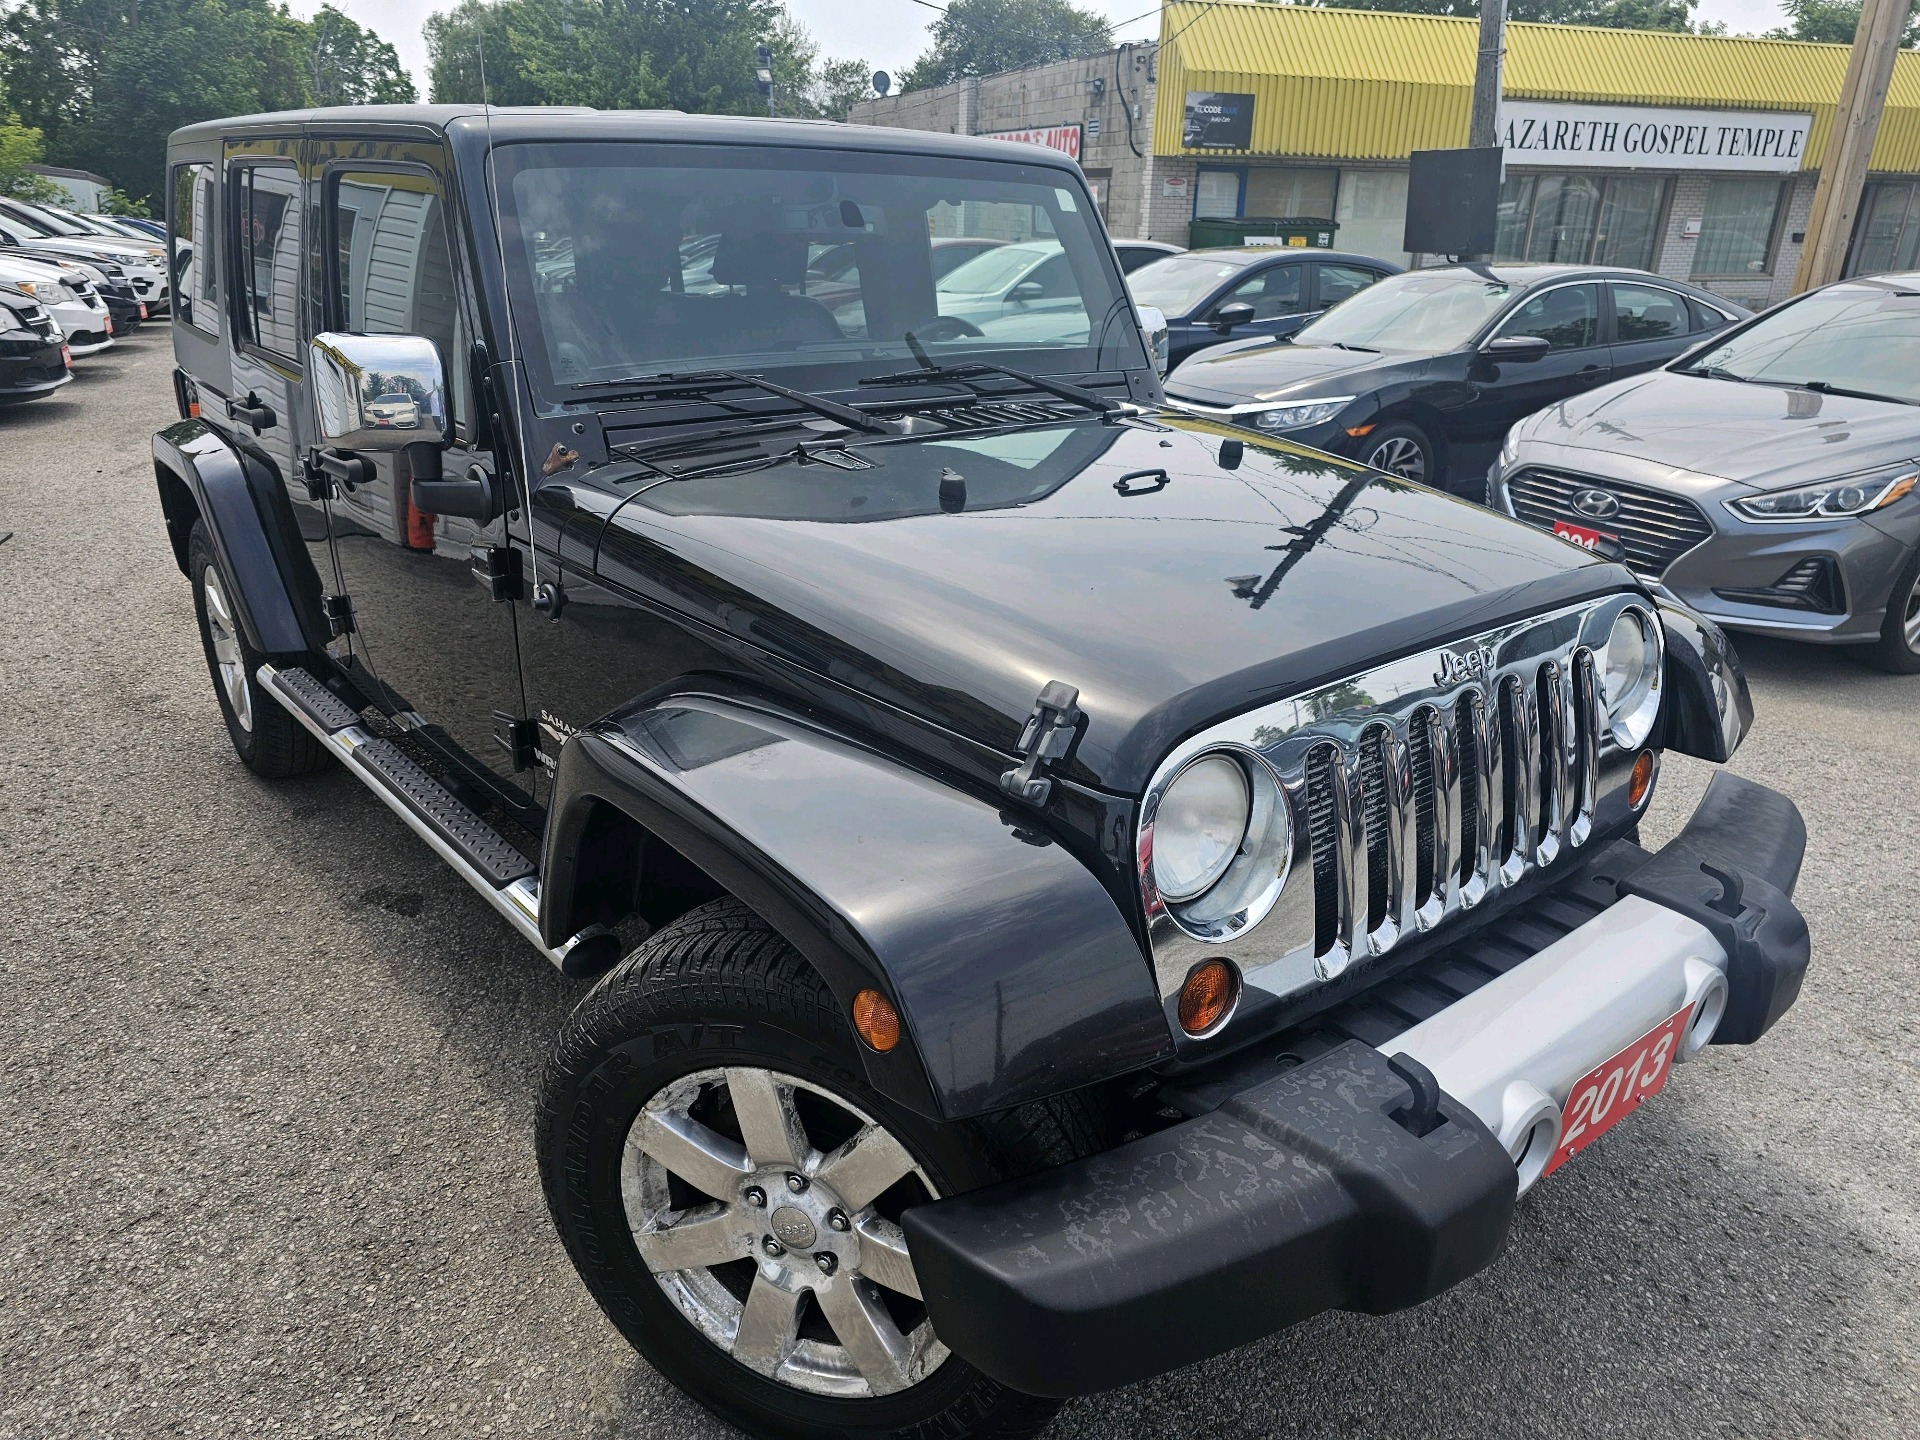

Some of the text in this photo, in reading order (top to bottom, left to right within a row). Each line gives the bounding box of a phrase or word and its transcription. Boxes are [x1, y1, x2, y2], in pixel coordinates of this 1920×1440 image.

[1203, 105, 1222, 114] CODE
[1046, 127, 1079, 158] AUTO
[1501, 118, 1803, 158] AZARETH GOSPEL TEMPLE
[1433, 646, 1494, 687] Jeep
[1560, 1031, 1674, 1149] 2013
